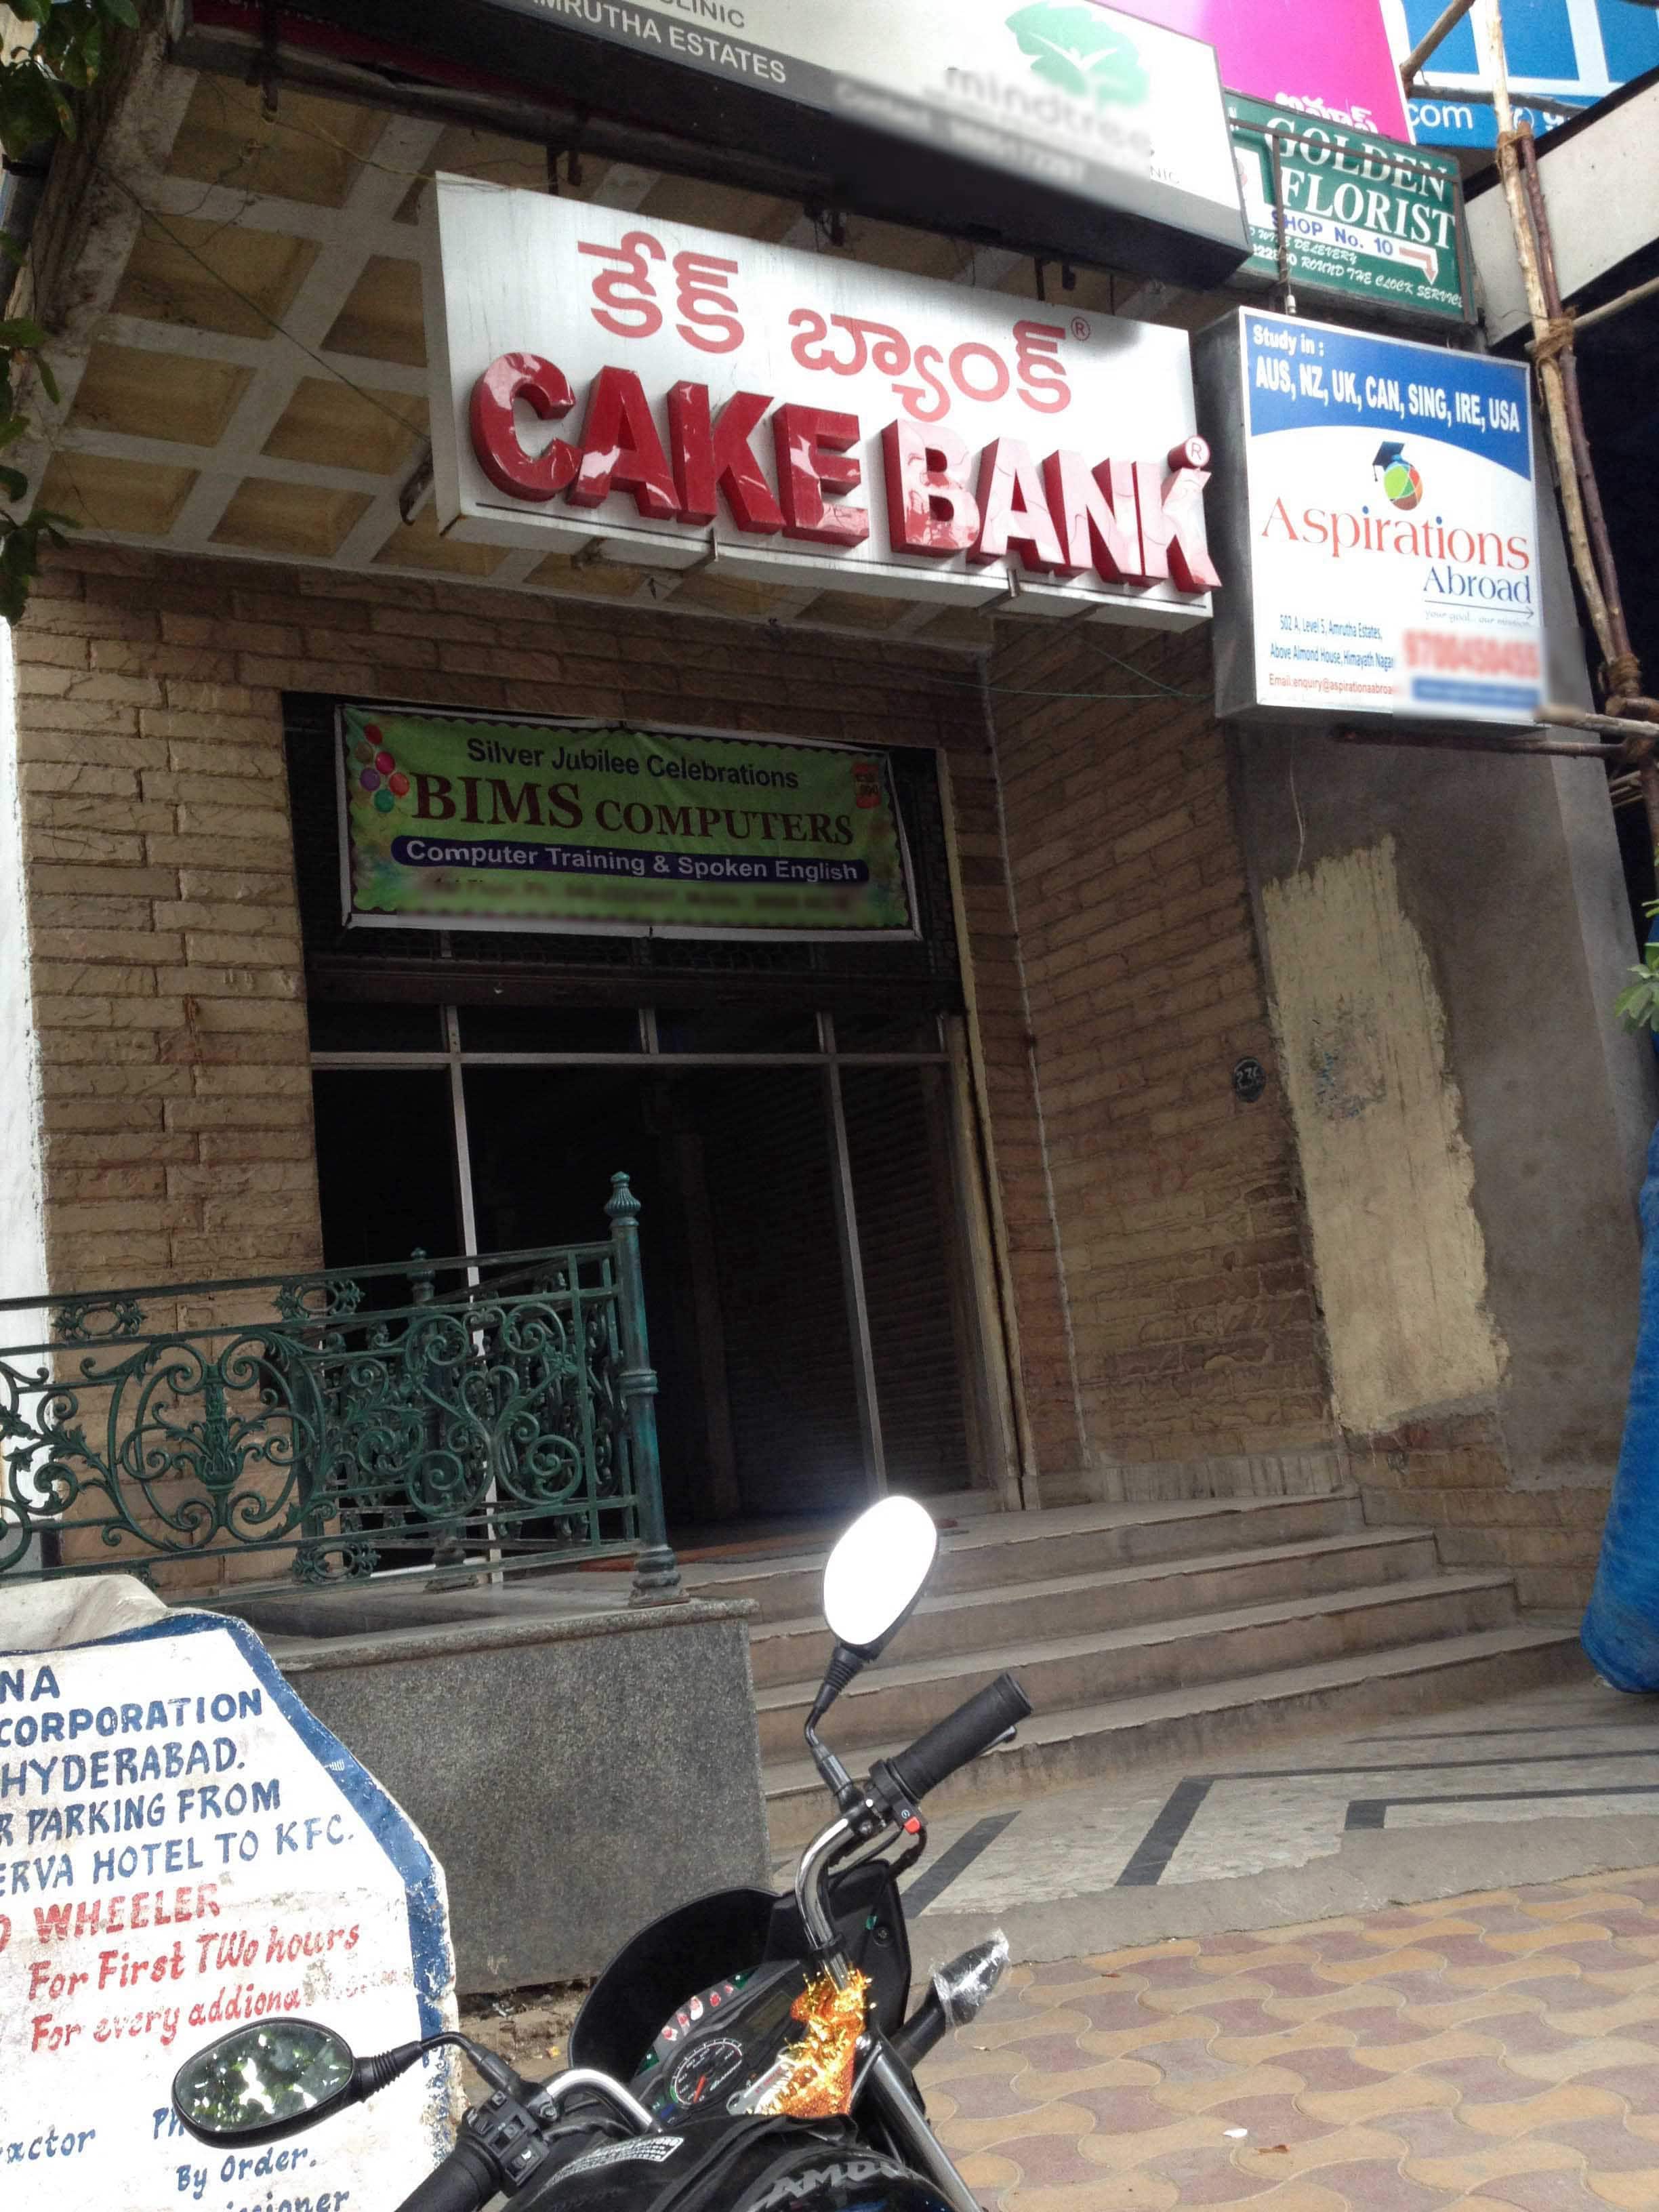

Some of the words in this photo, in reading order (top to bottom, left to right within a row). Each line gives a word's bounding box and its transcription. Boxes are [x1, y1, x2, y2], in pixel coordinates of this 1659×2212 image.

[534, 0, 661, 43] MRUTHA
[668, 26, 786, 84] ESTATES
[659, 0, 744, 28] LINIC
[1264, 117, 1448, 201] GOLDEN
[1271, 211, 1323, 237] SHOP
[1334, 226, 1364, 249] No.
[1374, 237, 1393, 255] 10
[1281, 166, 1457, 249] FLORIST
[1347, 267, 1373, 285] THE
[1376, 275, 1414, 294] CLOCK
[1252, 324, 1297, 356] Study
[1256, 356, 1296, 401] AUS,
[1299, 363, 1329, 406] NZ,
[1332, 370, 1362, 412] UK,
[1366, 375, 1404, 420] CAN,
[1408, 383, 1452, 428] SING,
[1455, 392, 1486, 433] IRE,
[1488, 398, 1521, 433] USA
[469, 352, 870, 548] CAKE
[881, 417, 1223, 594] BANK
[1261, 496, 1530, 570] Aspirations
[1423, 565, 1532, 603] Abroad
[1303, 617, 1319, 634] Level
[1328, 619, 1356, 638] Amrutha
[1271, 643, 1291, 660] Above
[1294, 644, 1318, 661] Almond
[1344, 650, 1374, 670] Himayath
[467, 737, 545, 766] Silver
[552, 746, 640, 777] Jubilee
[646, 754, 800, 789] Celebrations
[409, 771, 583, 829] BIMS
[594, 798, 855, 846] COMPUTERS
[406, 840, 539, 867] Computer
[545, 847, 645, 877] Training
[653, 854, 671, 874] &
[678, 857, 767, 880] Spoken
[775, 860, 858, 882] English
[0, 1687, 263, 1748] CORPORATION
[1, 1736, 245, 1799] HYDERABAD.
[26, 1793, 165, 1845] PARKING
[178, 1778, 281, 1824] FROM
[93, 1837, 203, 1885] HOTEL
[215, 1829, 259, 1864] TO
[33, 1883, 221, 1944] WHEELER
[28, 1960, 89, 2002] For
[98, 1940, 185, 1990] First
[265, 1923, 361, 1965] hours
[30, 2011, 85, 2053] For
[0, 2124, 96, 2164] actor
[176, 2164, 207, 2200] By
